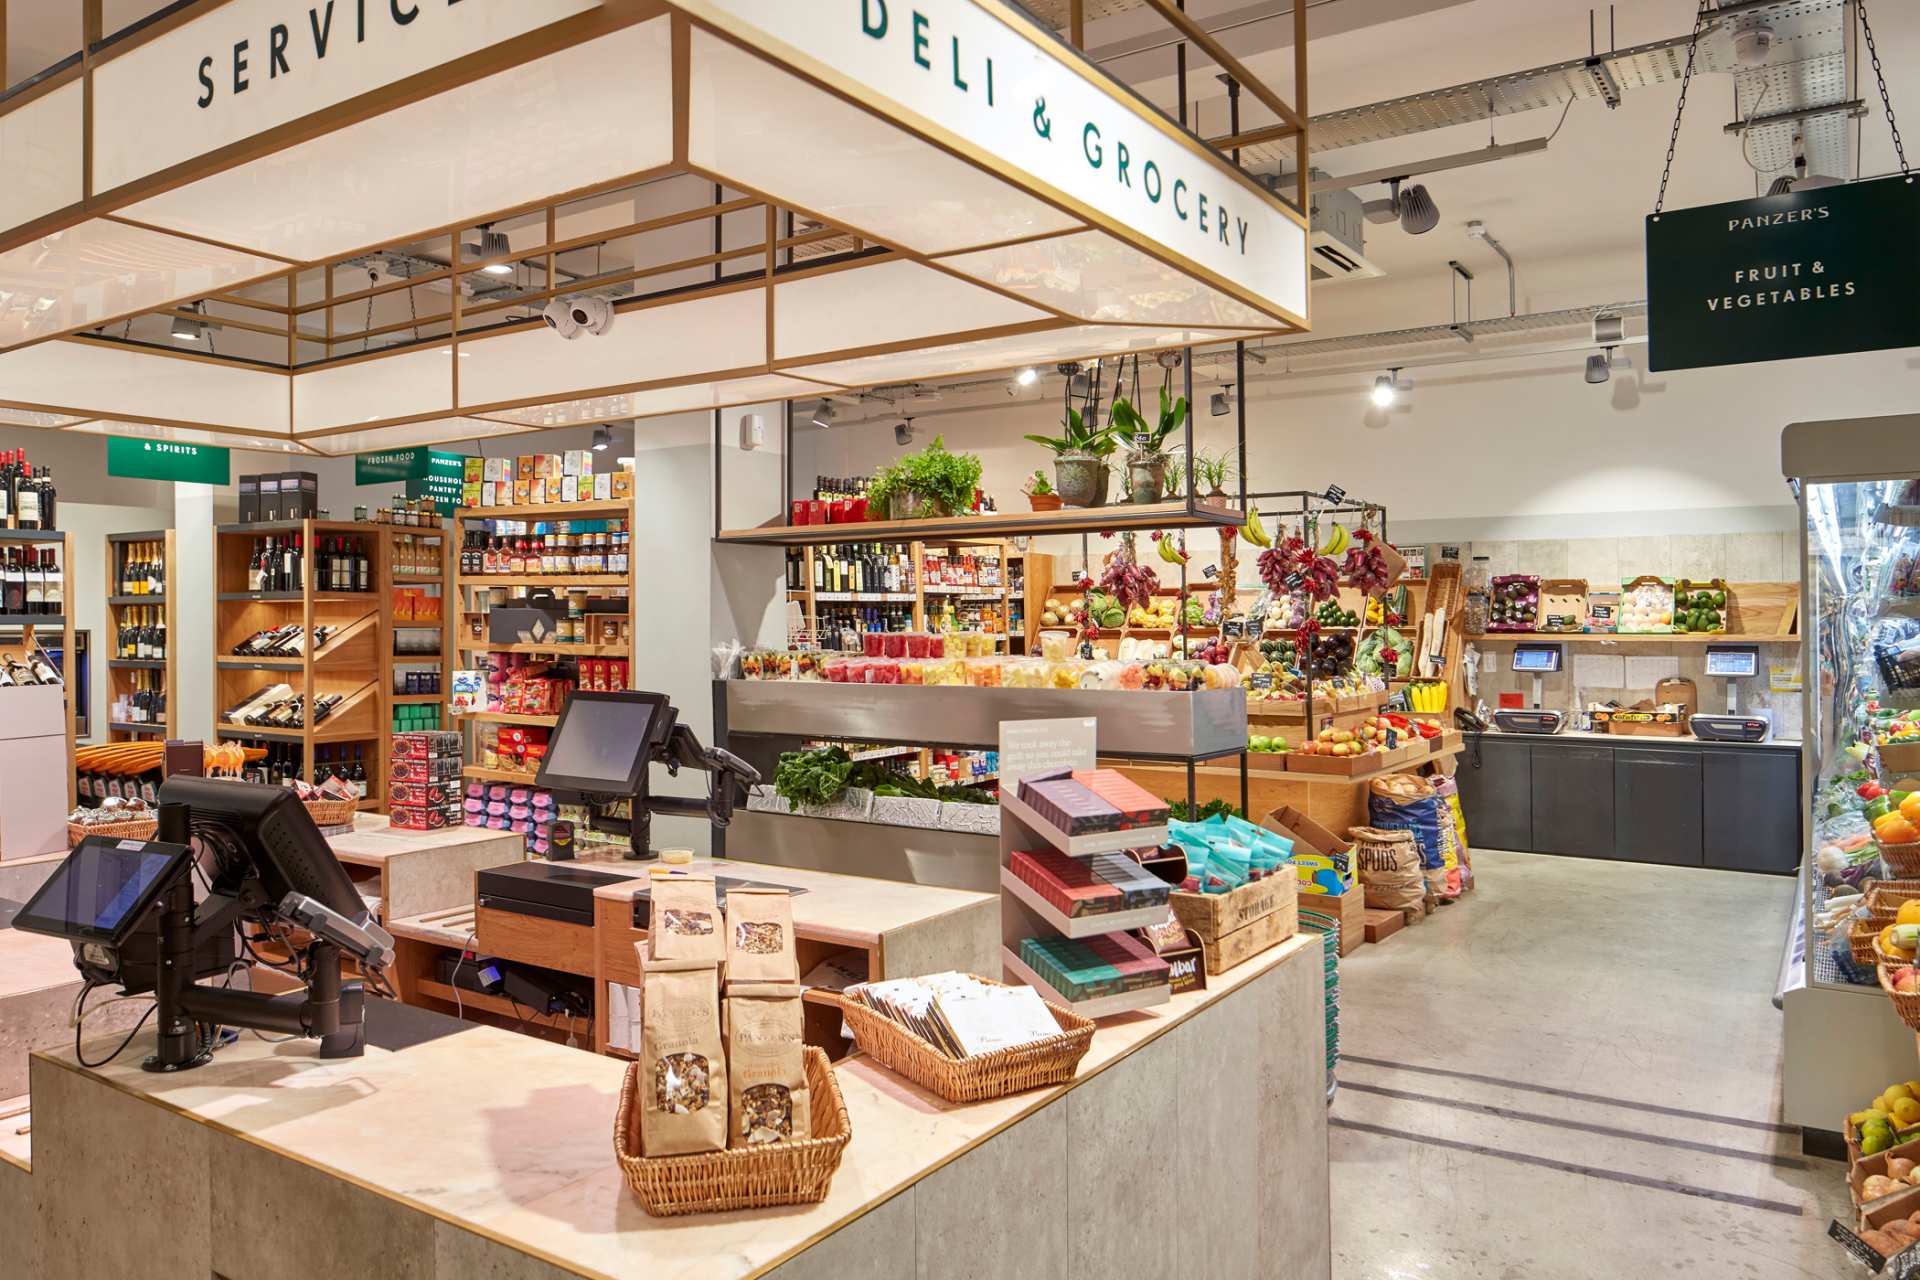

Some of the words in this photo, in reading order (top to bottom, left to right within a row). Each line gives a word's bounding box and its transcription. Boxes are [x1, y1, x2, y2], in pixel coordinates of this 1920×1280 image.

[197, 0, 467, 108] SERVIC
[862, 0, 994, 107] DELI
[1032, 96, 1052, 142] &
[1083, 122, 1248, 255] GROCERY
[1728, 206, 1830, 231] PANZER'S
[1735, 263, 1803, 284] FRUIT
[1812, 261, 1825, 274] &
[1707, 282, 1856, 312] VEGETABLES
[144, 443, 151, 451] &
[156, 443, 198, 456] SPIRITS
[429, 485, 456, 494] PANTRY
[1358, 848, 1398, 871] SPUDS
